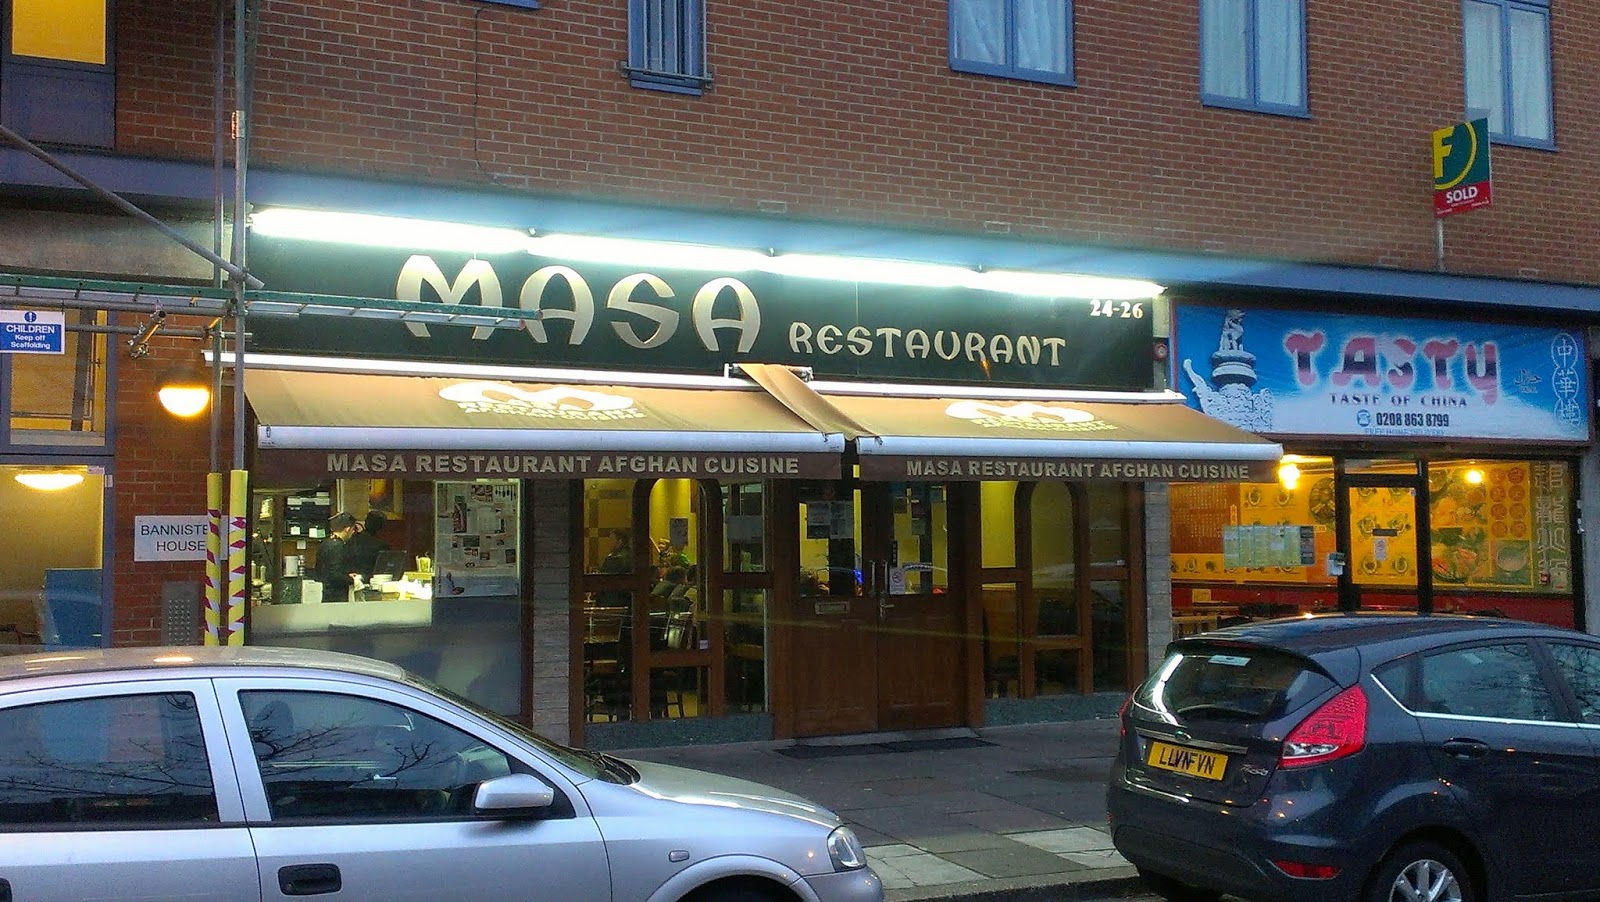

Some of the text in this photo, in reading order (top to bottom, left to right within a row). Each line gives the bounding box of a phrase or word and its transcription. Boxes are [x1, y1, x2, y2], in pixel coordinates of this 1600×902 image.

[1446, 186, 1478, 204] SOLD
[396, 254, 1066, 367] MASA RESTAURANT
[1089, 299, 1144, 319] 24-26
[6, 324, 55, 334] CHILDREN
[11, 341, 51, 350] Scaffolding
[15, 334, 33, 342] Keep
[1284, 331, 1498, 405] TASTY
[1329, 392, 1468, 407] TASTE OF CHINA
[1376, 412, 1450, 427] 0208 863 8799
[327, 453, 799, 474] MASA RESTAURANT AFGHAN CUISINE
[906, 460, 1250, 479] MASA RESTAURANT AFGHAN CUISINE
[141, 524, 207, 536] BANNISTE
[156, 540, 206, 552] HOUSE
